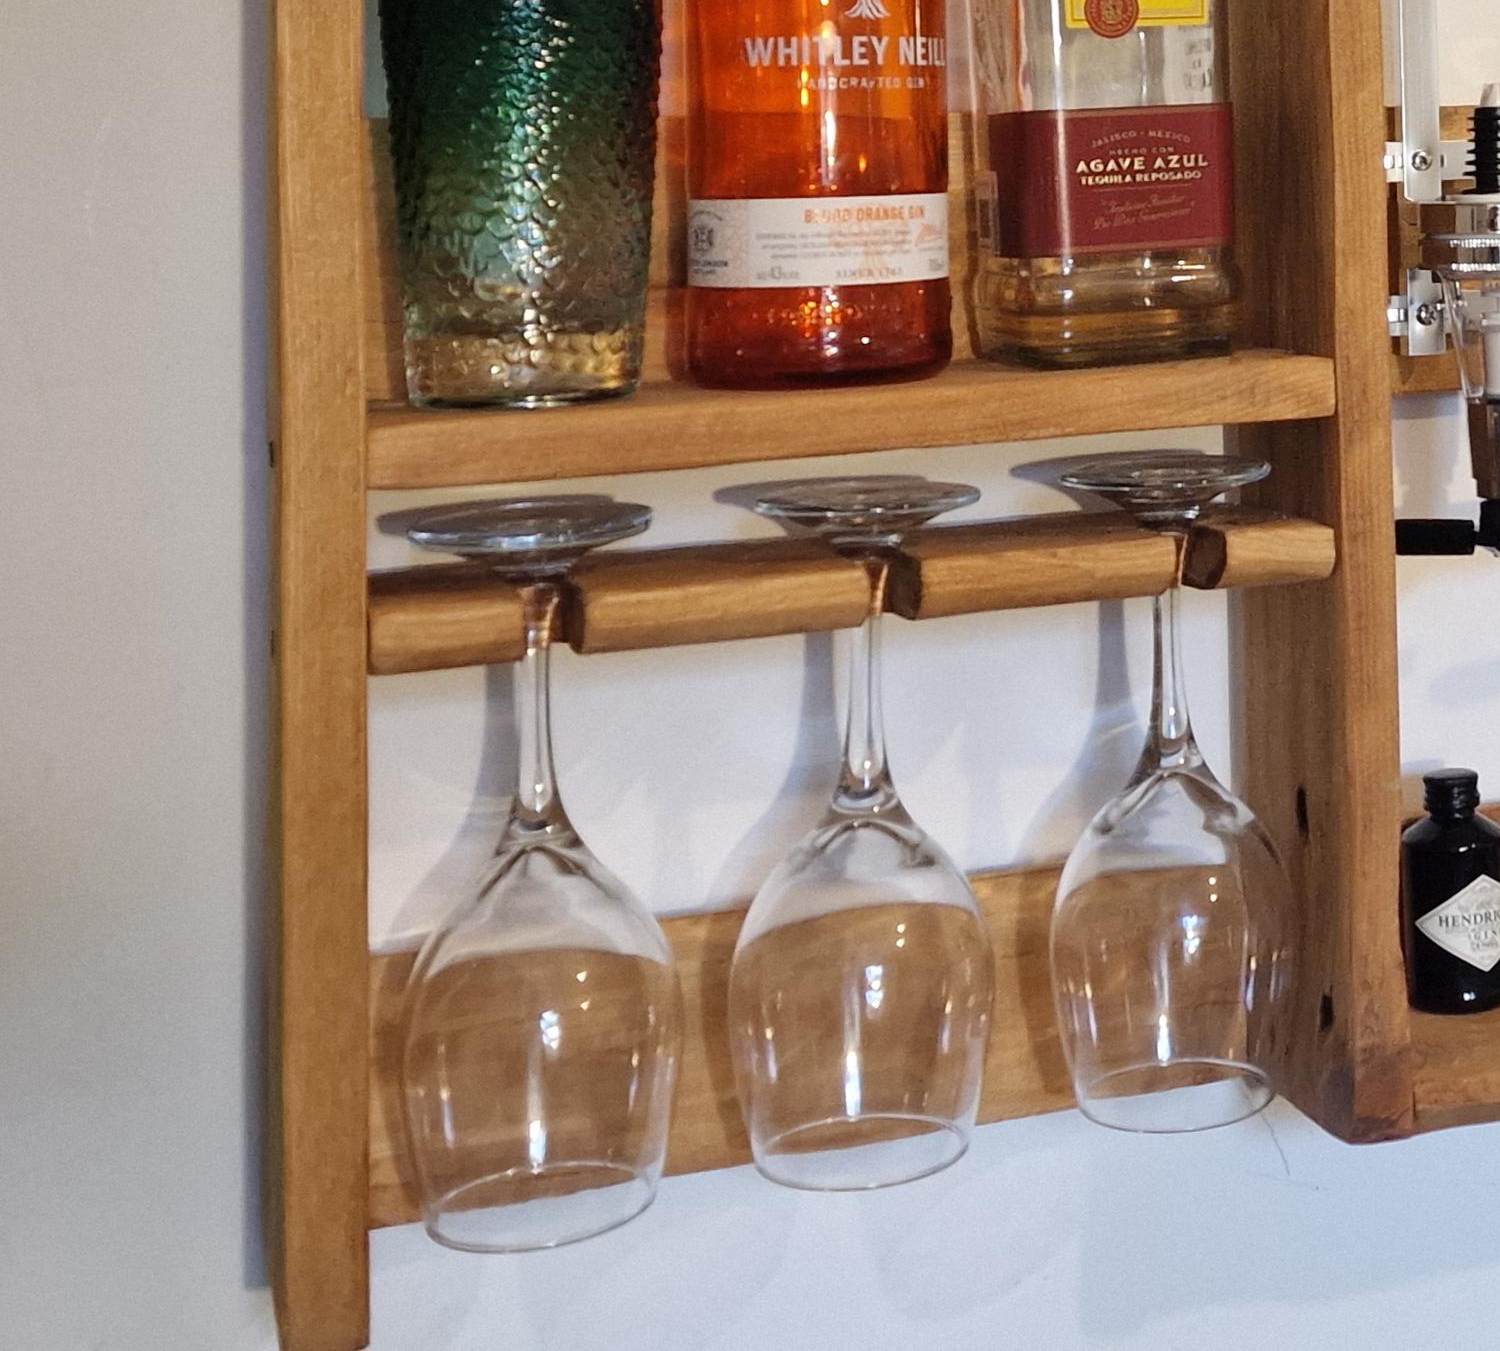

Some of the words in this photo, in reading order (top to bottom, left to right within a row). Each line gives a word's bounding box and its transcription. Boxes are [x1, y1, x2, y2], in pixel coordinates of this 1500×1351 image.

[744, 36, 890, 67] WHITLEY
[899, 33, 945, 66] NEILL
[1075, 156, 1146, 174] AGAVE
[1153, 153, 1209, 170] AZUL
[1080, 174, 1133, 186] TEQUILA
[1135, 170, 1202, 183] REPOSADO
[856, 206, 904, 222] ORANGE
[908, 204, 926, 219] GIN
